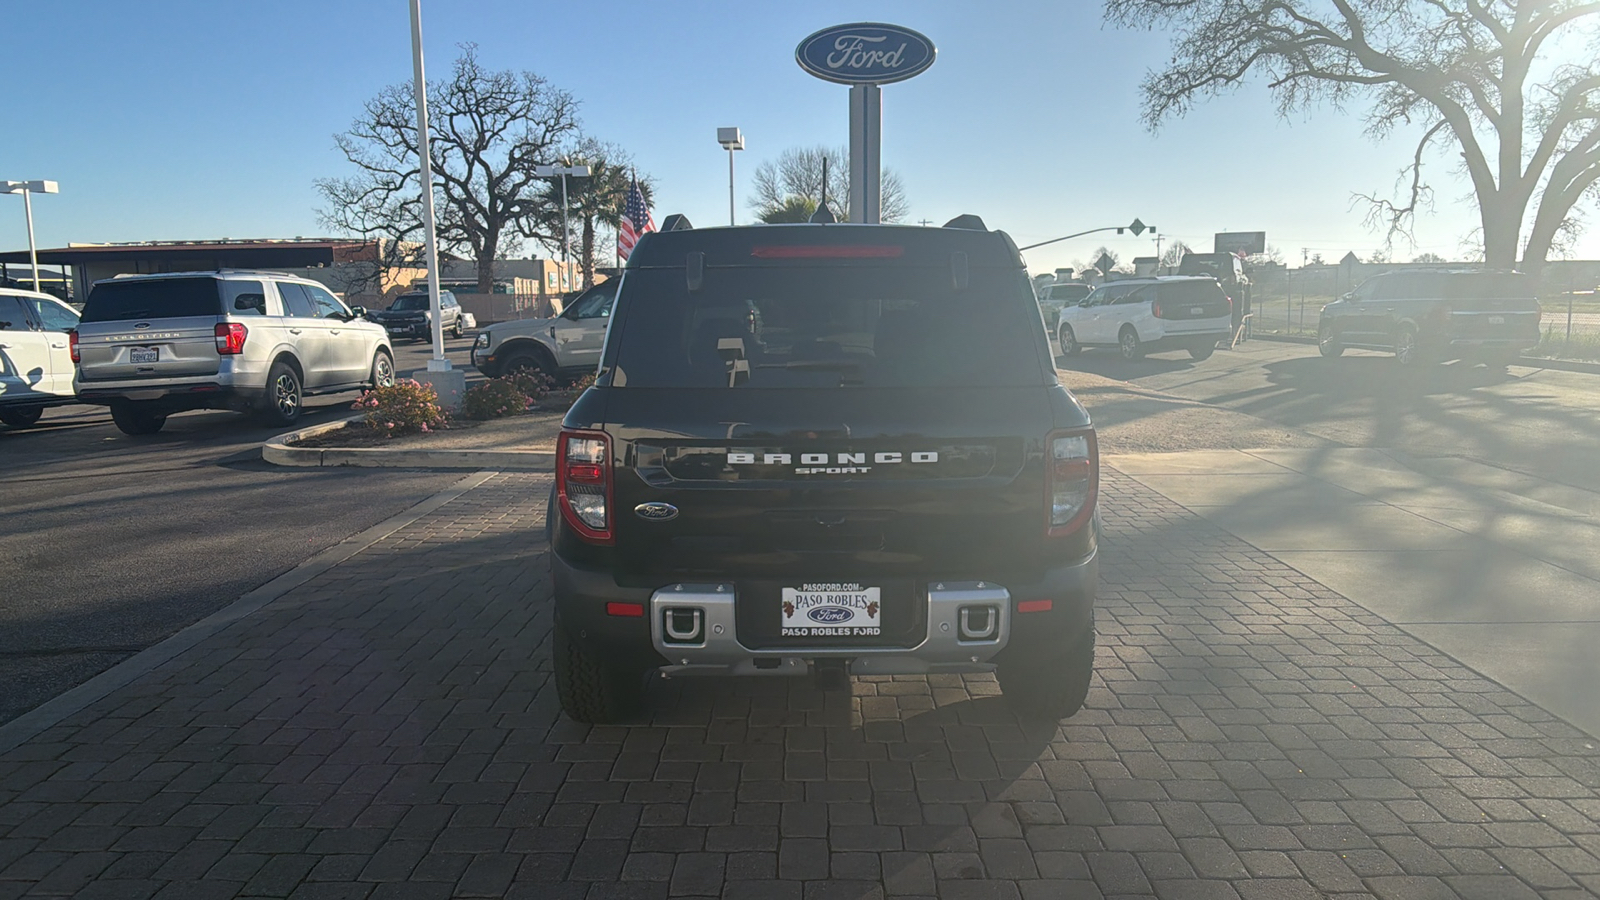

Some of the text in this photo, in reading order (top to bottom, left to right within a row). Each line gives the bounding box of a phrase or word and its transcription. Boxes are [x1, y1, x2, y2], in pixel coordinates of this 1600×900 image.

[827, 35, 907, 68] Ford
[105, 333, 180, 341] EXPEDITION
[727, 452, 938, 464] BRONCO
[644, 506, 668, 516] Ford
[803, 583, 859, 591] PASOFORD.COM
[795, 595, 867, 609] PASO ROBLES
[817, 608, 845, 620] Ford
[782, 628, 880, 636] PASO ROBLES FORD
